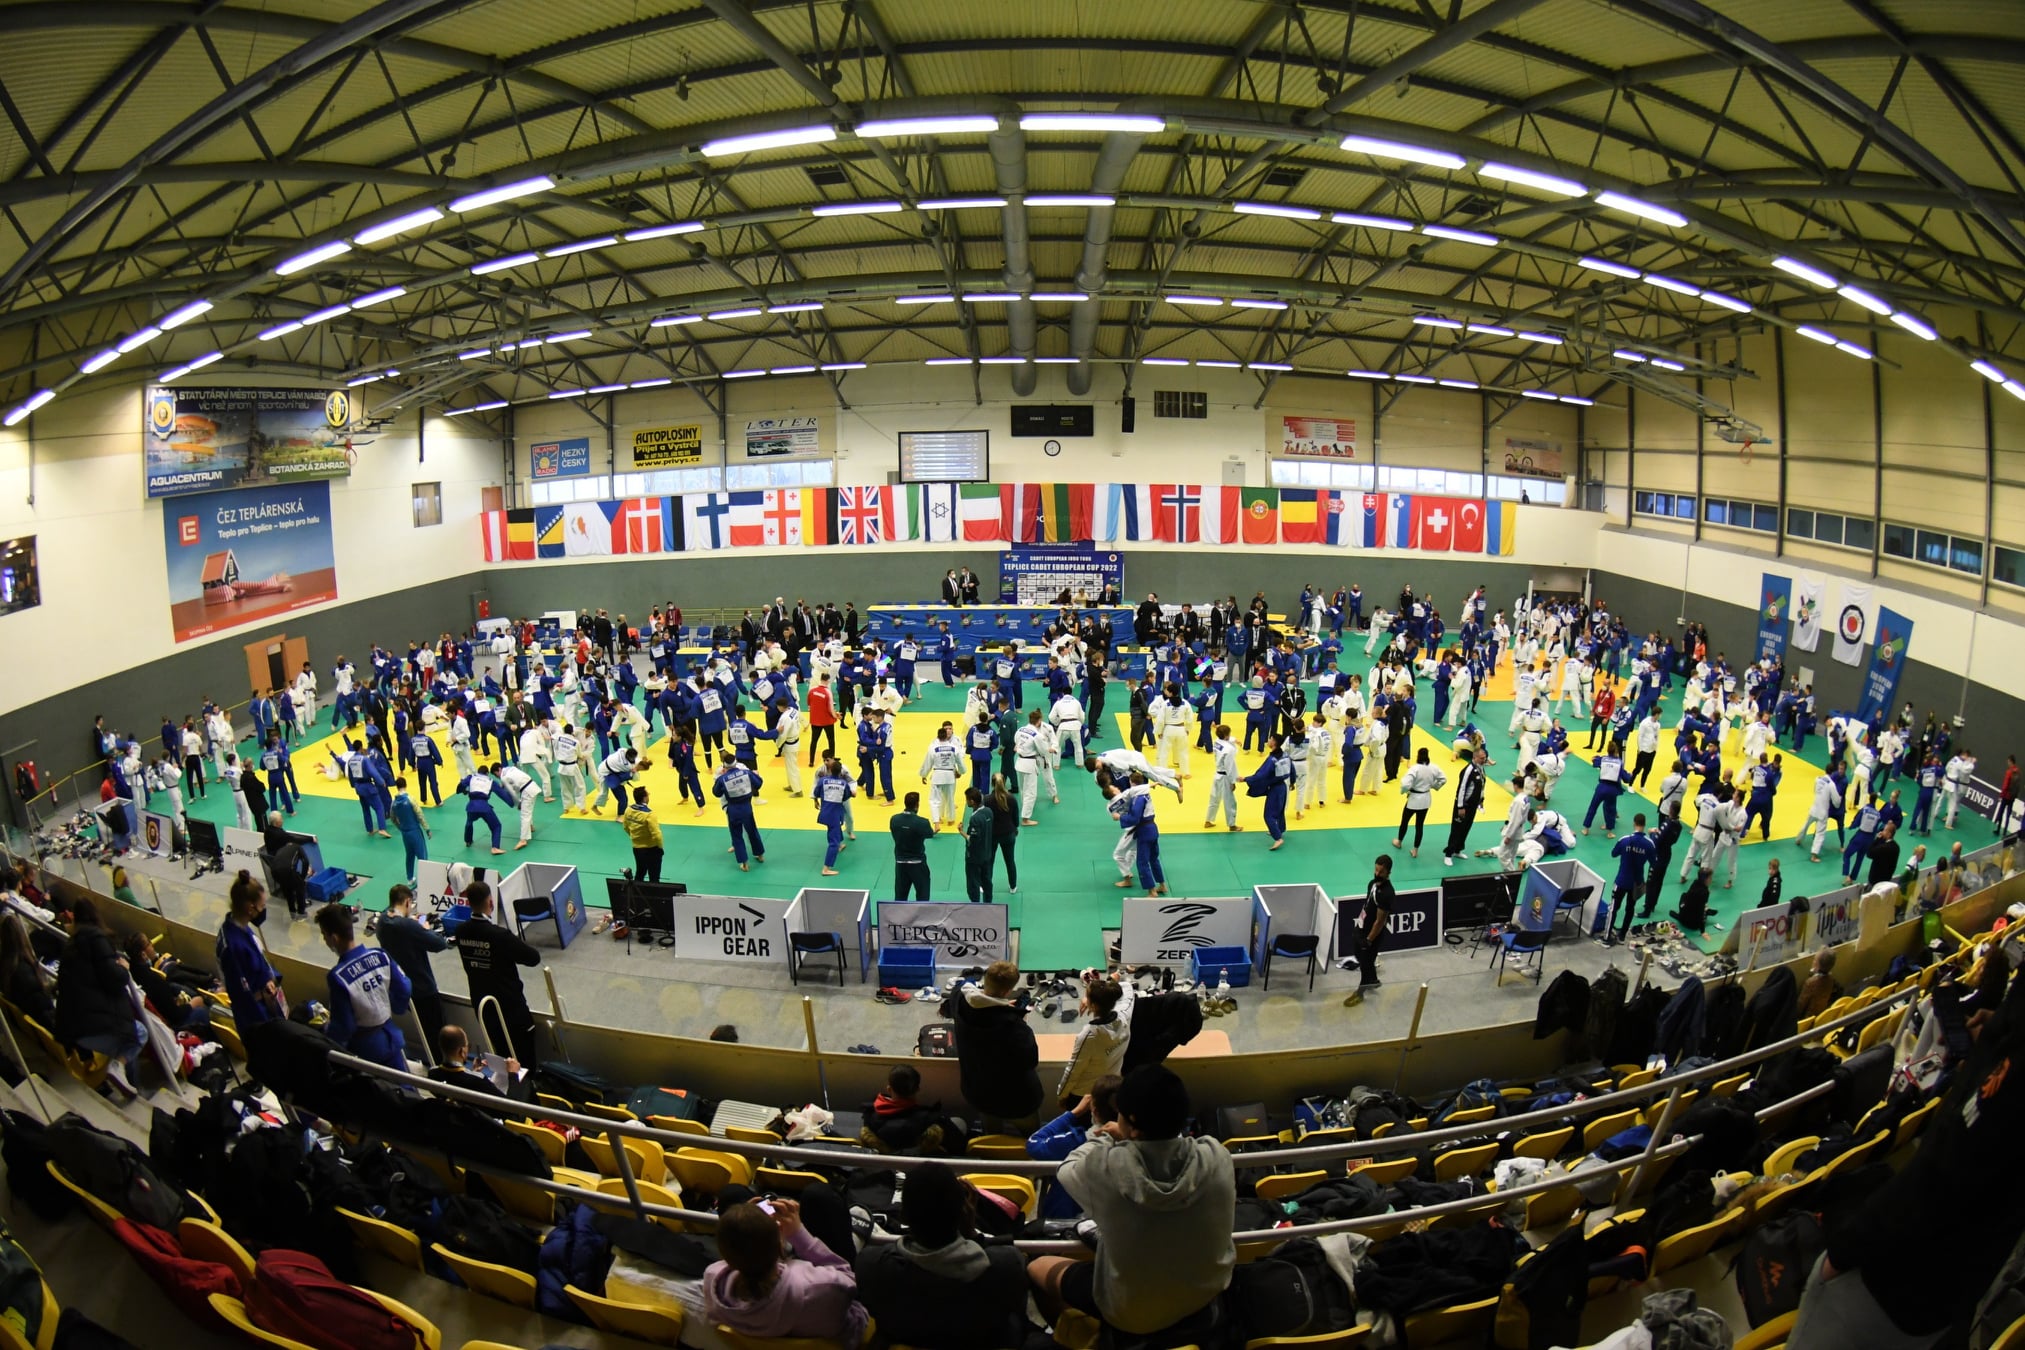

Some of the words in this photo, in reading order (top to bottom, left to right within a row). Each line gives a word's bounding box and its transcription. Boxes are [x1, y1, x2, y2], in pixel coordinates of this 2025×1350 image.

[179, 390, 229, 400] STATUTÁRNÍ
[258, 391, 286, 400] TEPLICE
[287, 390, 303, 400] VÁM
[562, 448, 586, 458] HEZKY
[269, 462, 313, 474] BOTANICKÁ
[562, 458, 586, 467] ČESKY
[217, 507, 236, 524] ČEZ
[239, 498, 304, 520] TEPLÁRENSKÁ
[218, 530, 236, 539] Teplo
[238, 528, 249, 536] pro
[250, 523, 272, 533] Teplice
[279, 520, 294, 529] teplo
[296, 519, 305, 527] pro
[306, 516, 320, 524] halu
[1101, 563, 1117, 571] 2022
[1965, 787, 1994, 809] FINEP
[695, 916, 746, 936] IPPON
[460, 938, 490, 949] HAMBURG
[723, 936, 770, 957] GEAR
[347, 961, 364, 978] CARL
[362, 974, 383, 992] GER
